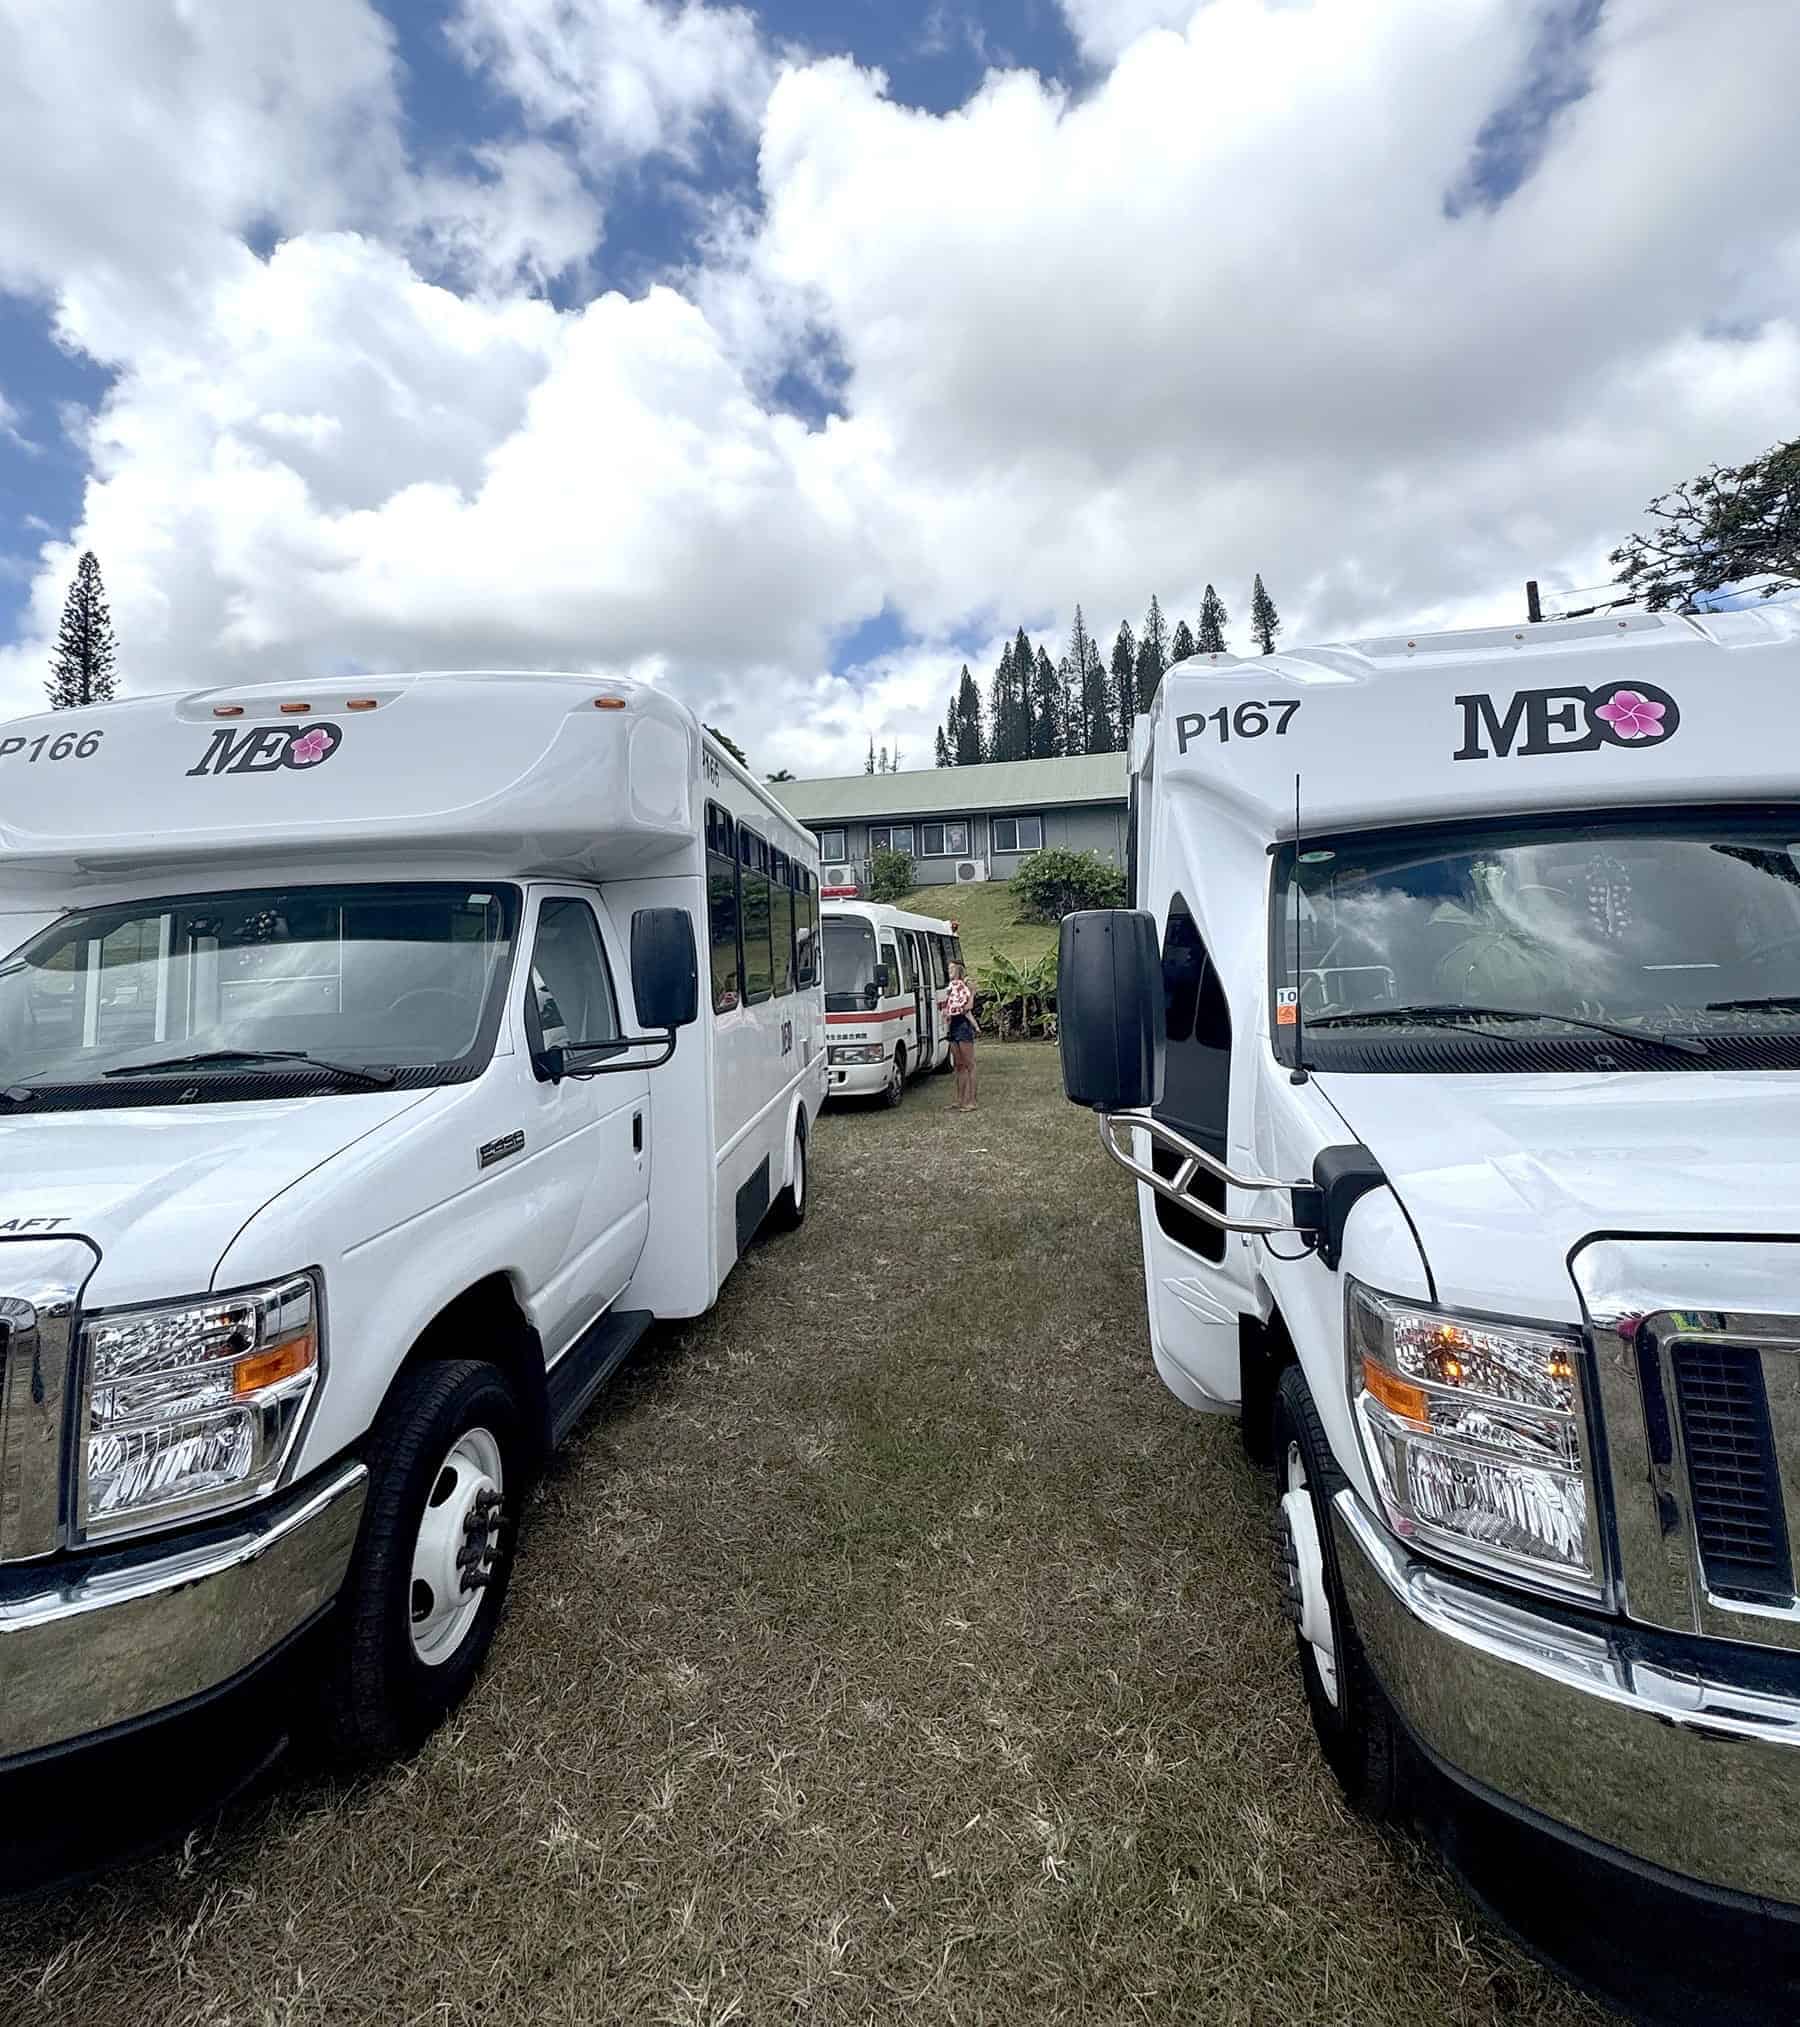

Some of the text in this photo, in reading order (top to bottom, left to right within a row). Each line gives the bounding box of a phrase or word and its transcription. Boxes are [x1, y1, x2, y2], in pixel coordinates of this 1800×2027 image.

[0, 730, 104, 762] P166
[1176, 700, 1301, 755] P167
[1453, 680, 1680, 760] MEO
[185, 722, 343, 776] MEO
